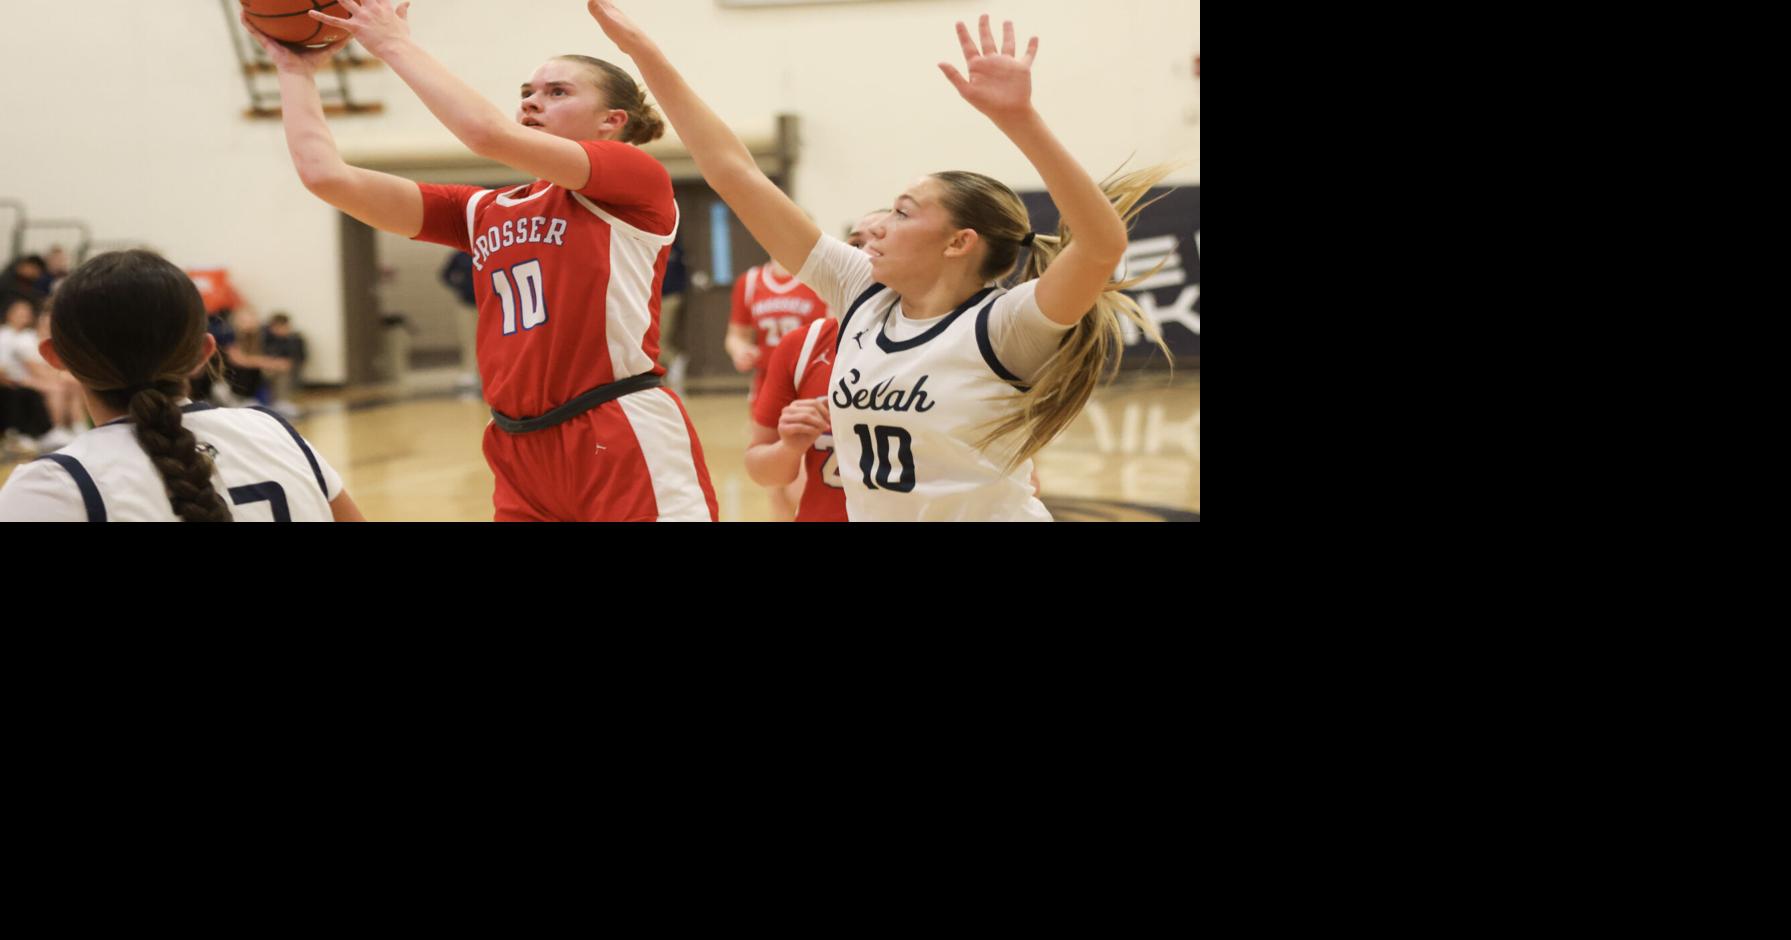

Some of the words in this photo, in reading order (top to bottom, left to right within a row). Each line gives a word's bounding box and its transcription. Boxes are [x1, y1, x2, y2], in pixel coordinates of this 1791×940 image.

[472, 215, 568, 272] PROSSER
[491, 257, 550, 336] 10
[832, 368, 936, 413] Selah
[853, 423, 917, 494] 10
